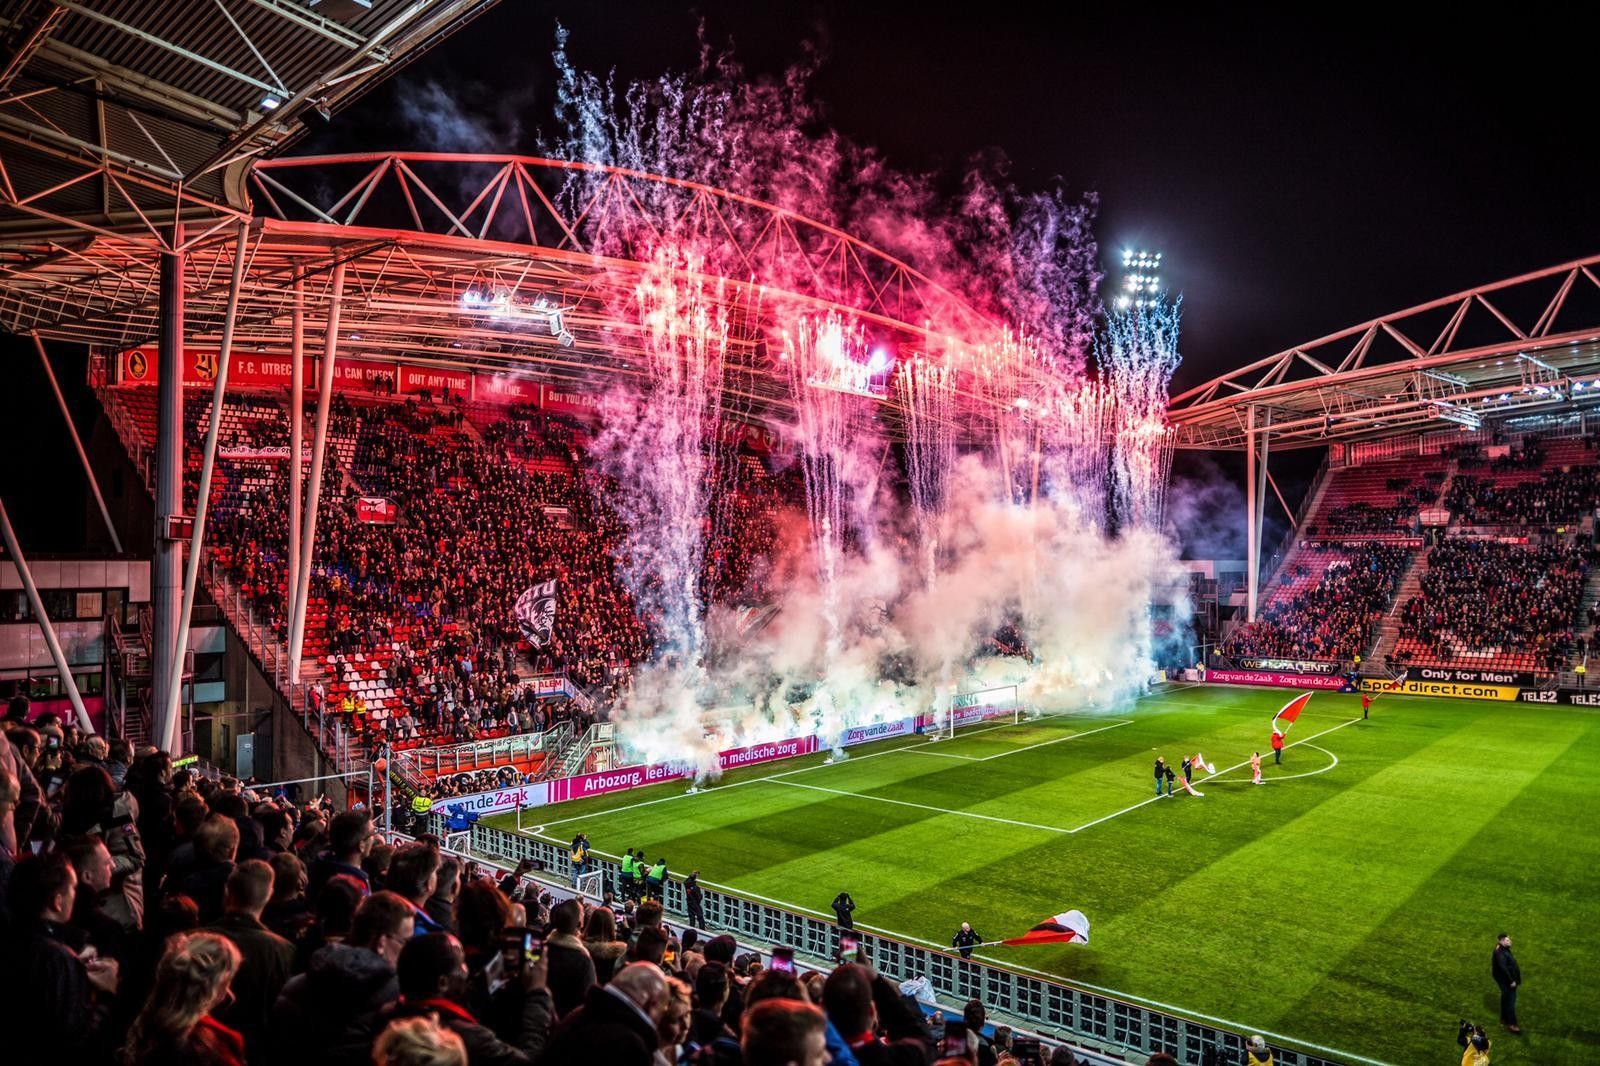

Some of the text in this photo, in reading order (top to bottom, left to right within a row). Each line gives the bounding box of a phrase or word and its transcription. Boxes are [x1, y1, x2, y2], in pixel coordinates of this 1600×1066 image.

[238, 361, 293, 377] F.C. UTREC
[344, 367, 363, 380] CAN
[366, 368, 395, 382] CHECK
[409, 373, 466, 390] OUT ANY TIME
[565, 393, 580, 405] YOU
[1212, 671, 1273, 682] Zorg van de Zaak
[1279, 675, 1344, 687] Zorg van de Zaak
[1421, 669, 1452, 680] Only
[1455, 670, 1477, 681] for
[1521, 690, 1558, 703] TELE2
[847, 721, 905, 740] Zorg van de Zaak
[584, 771, 643, 792] Arbozorg,
[729, 746, 776, 764] medische
[777, 742, 797, 755] zorg
[476, 795, 494, 808] de
[494, 788, 528, 806] Zaak
